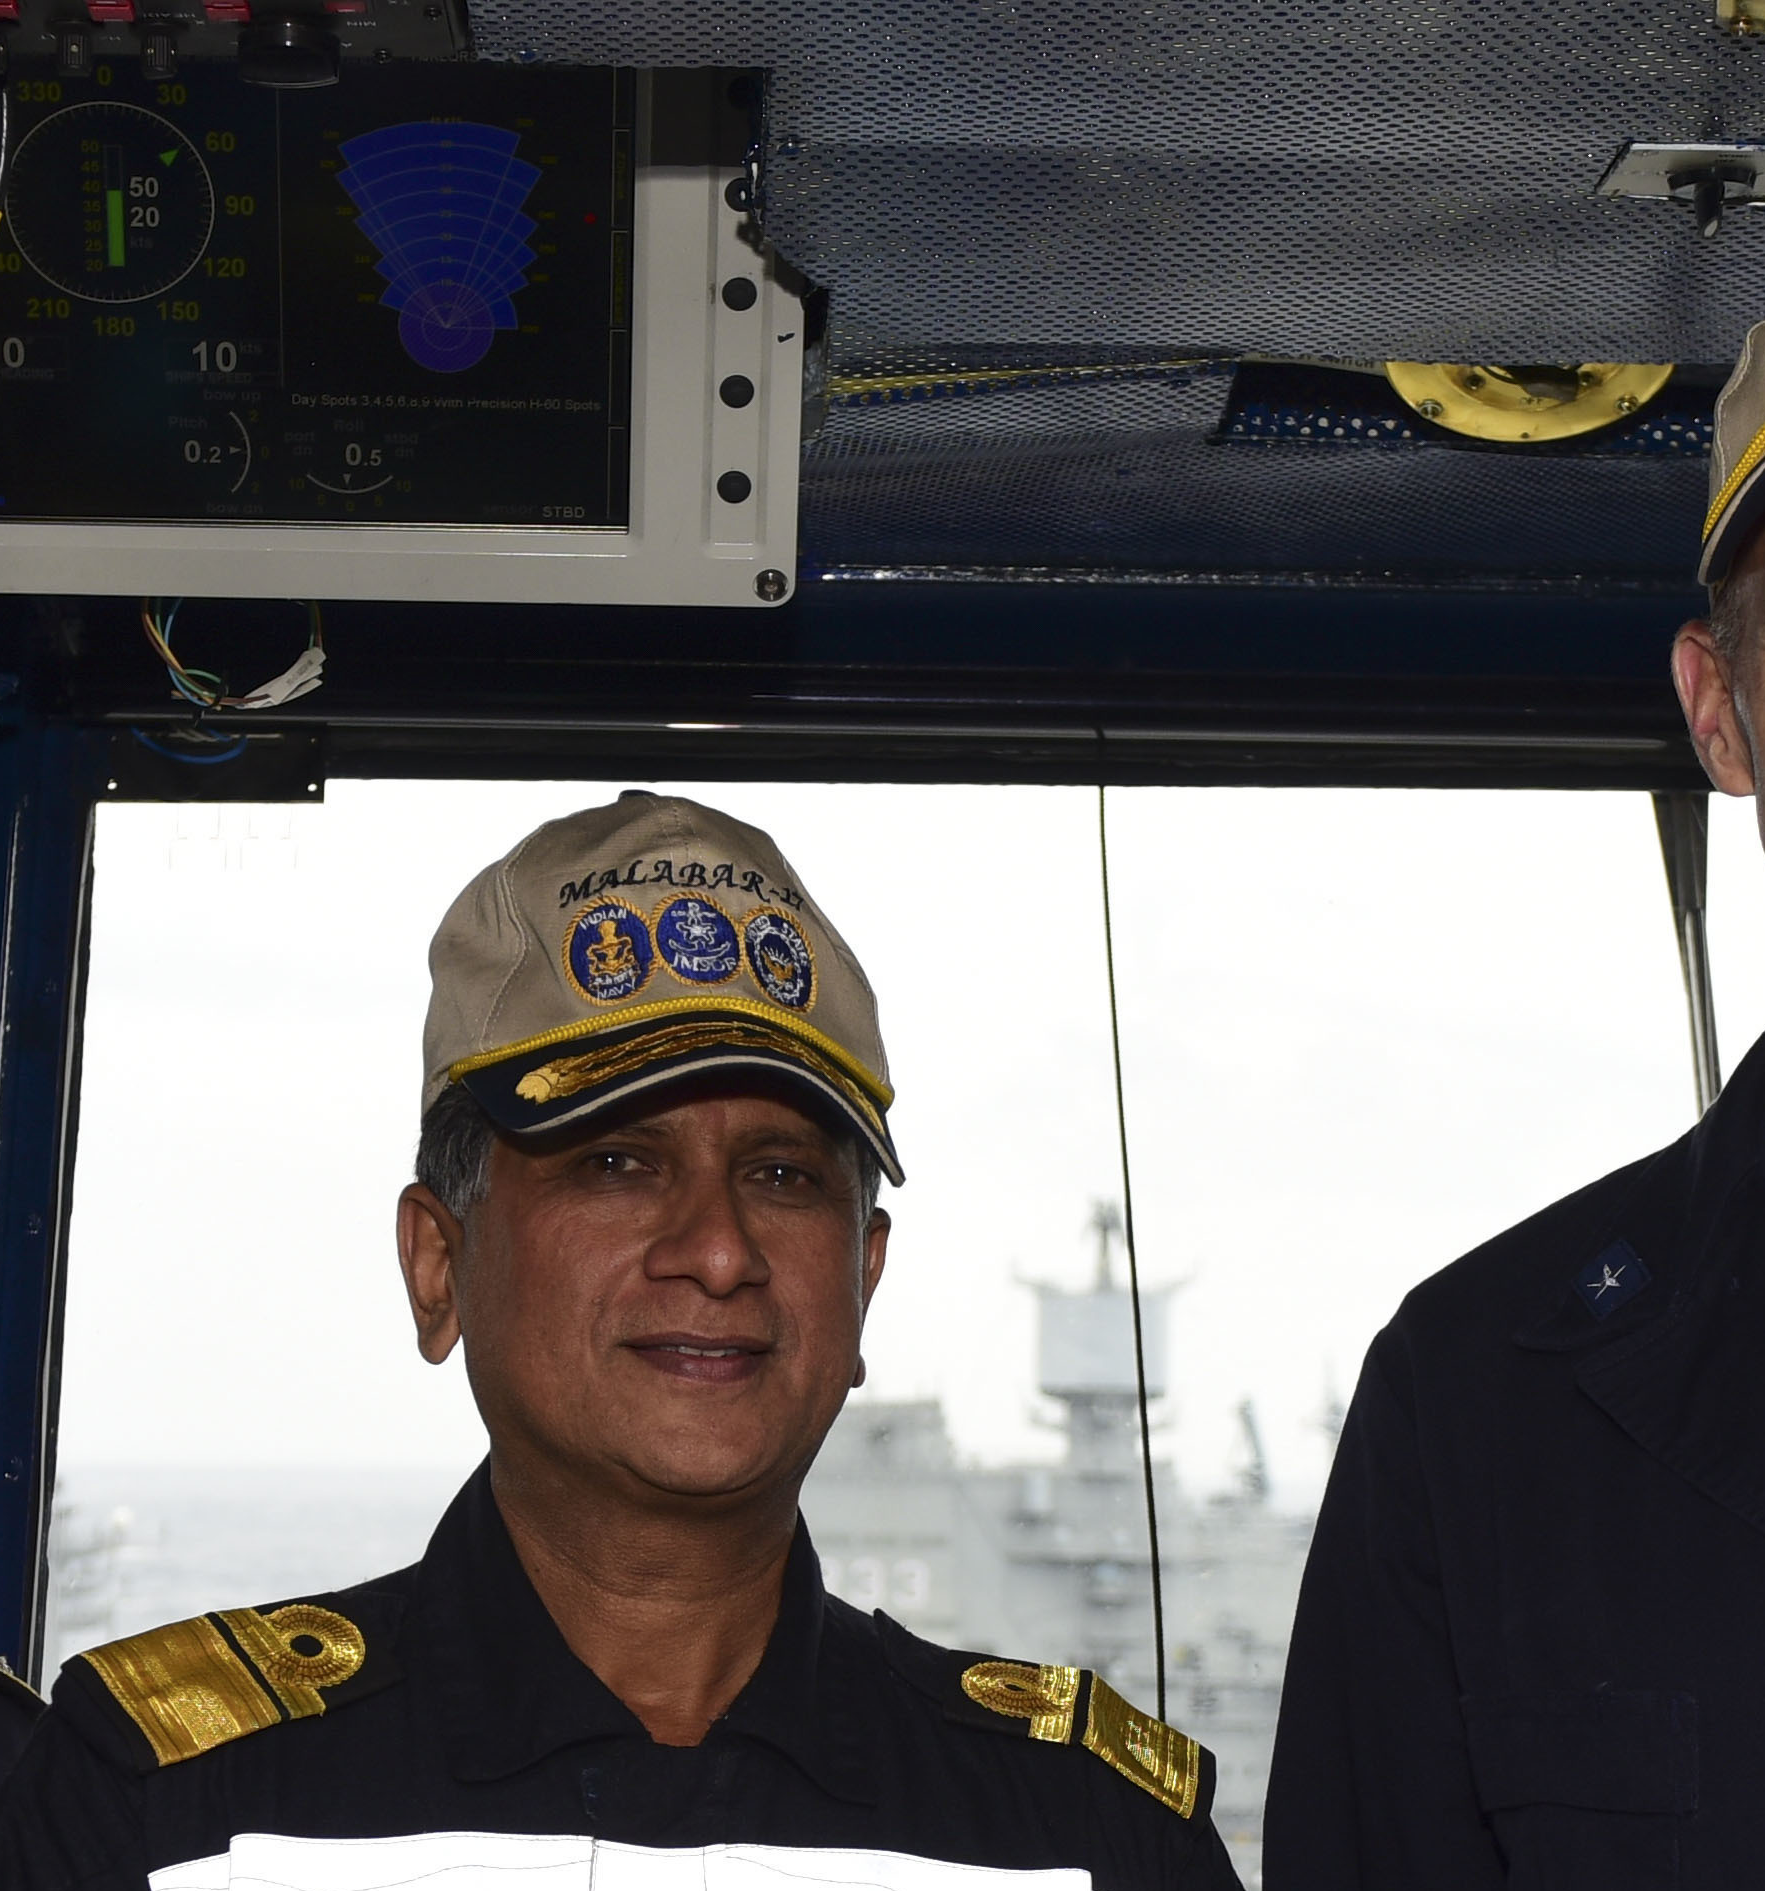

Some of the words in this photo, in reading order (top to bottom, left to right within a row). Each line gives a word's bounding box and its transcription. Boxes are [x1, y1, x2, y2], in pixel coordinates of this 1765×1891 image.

[16, 80, 63, 102] 330
[156, 83, 189, 106] 30
[204, 130, 237, 153] 60
[128, 176, 160, 199] 50
[129, 206, 161, 229] 20
[224, 195, 257, 217] 90
[202, 256, 247, 278] 120
[26, 297, 71, 320] 210
[156, 301, 201, 322] 150
[92, 316, 136, 337] 180
[191, 340, 238, 373] 10
[291, 393, 317, 408] Day
[184, 439, 222, 464] 0.2
[344, 442, 383, 467] 0.5
[541, 505, 586, 519] STBD
